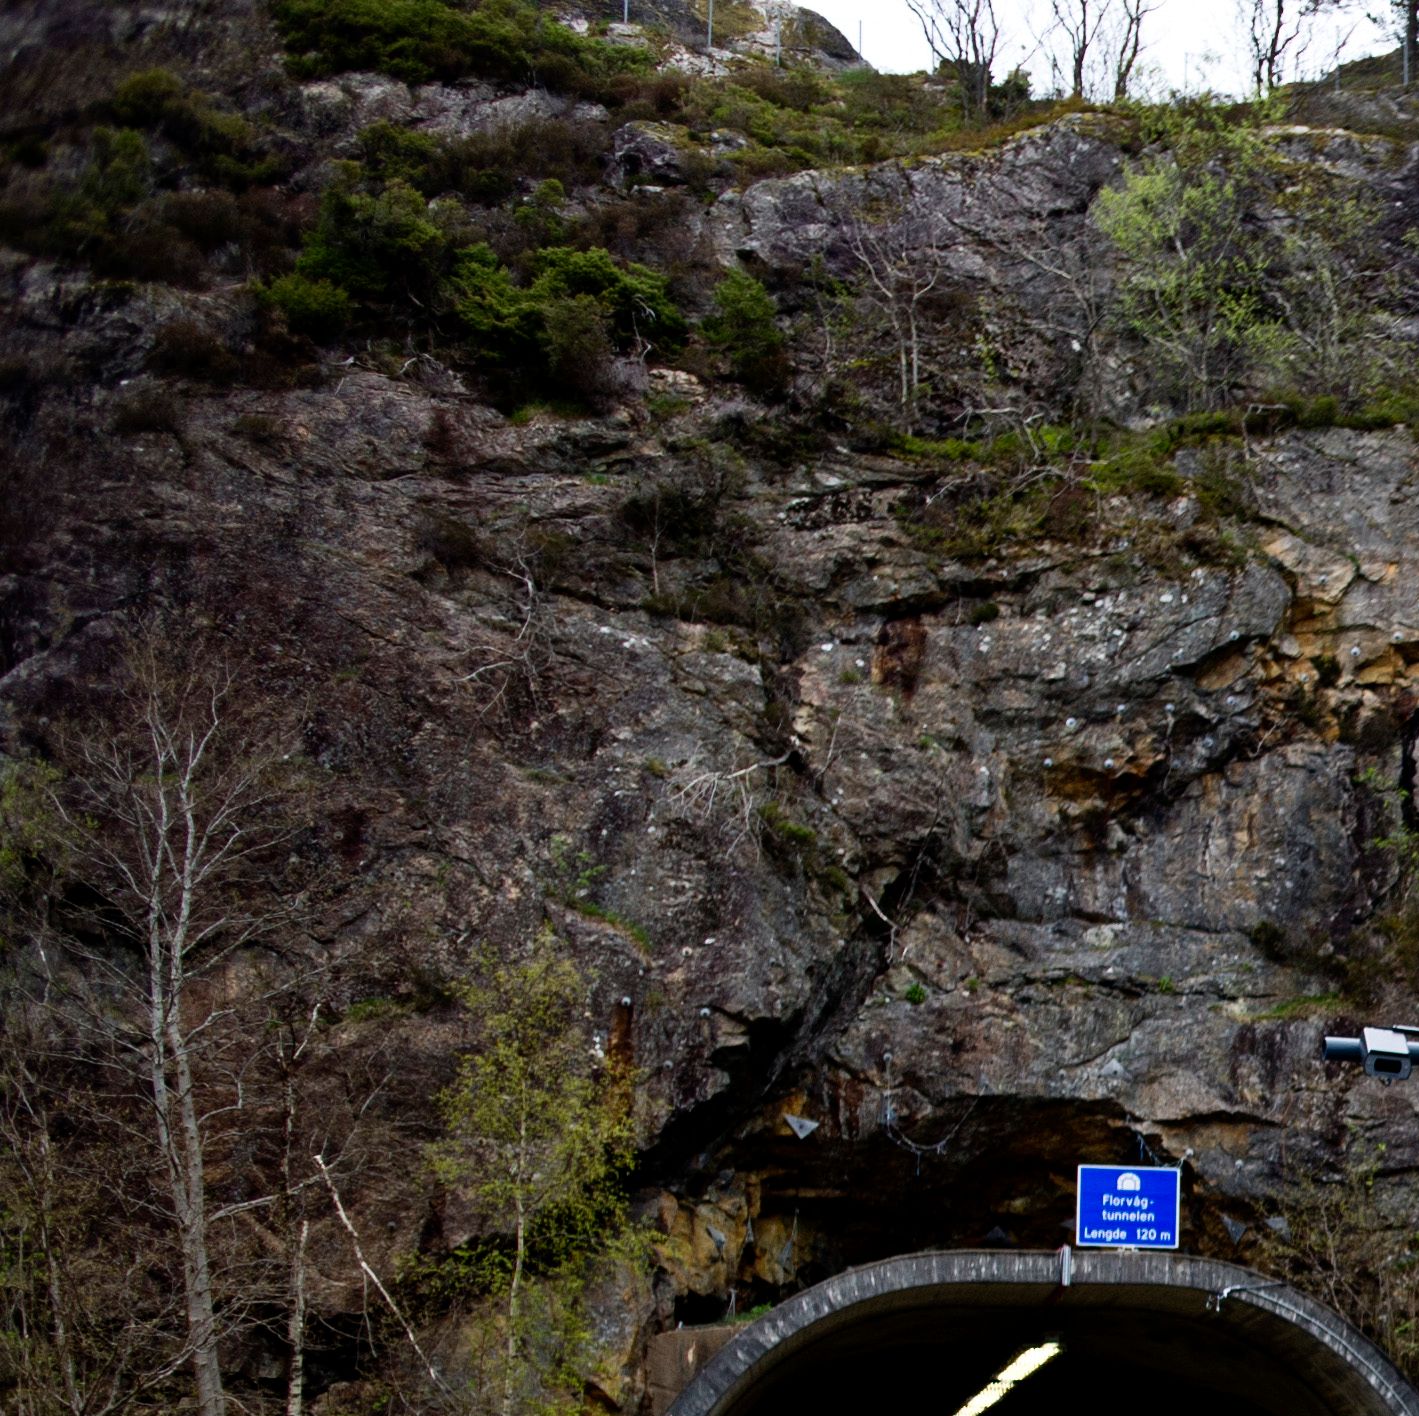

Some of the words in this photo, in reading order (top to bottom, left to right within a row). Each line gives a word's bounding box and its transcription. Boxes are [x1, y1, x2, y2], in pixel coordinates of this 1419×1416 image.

[1102, 1193, 1155, 1210] Florvåg-
[1102, 1209, 1155, 1222] tunnelen
[1084, 1226, 1127, 1241] Lengde
[1136, 1228, 1157, 1240] 120
[1160, 1231, 1171, 1241] m
